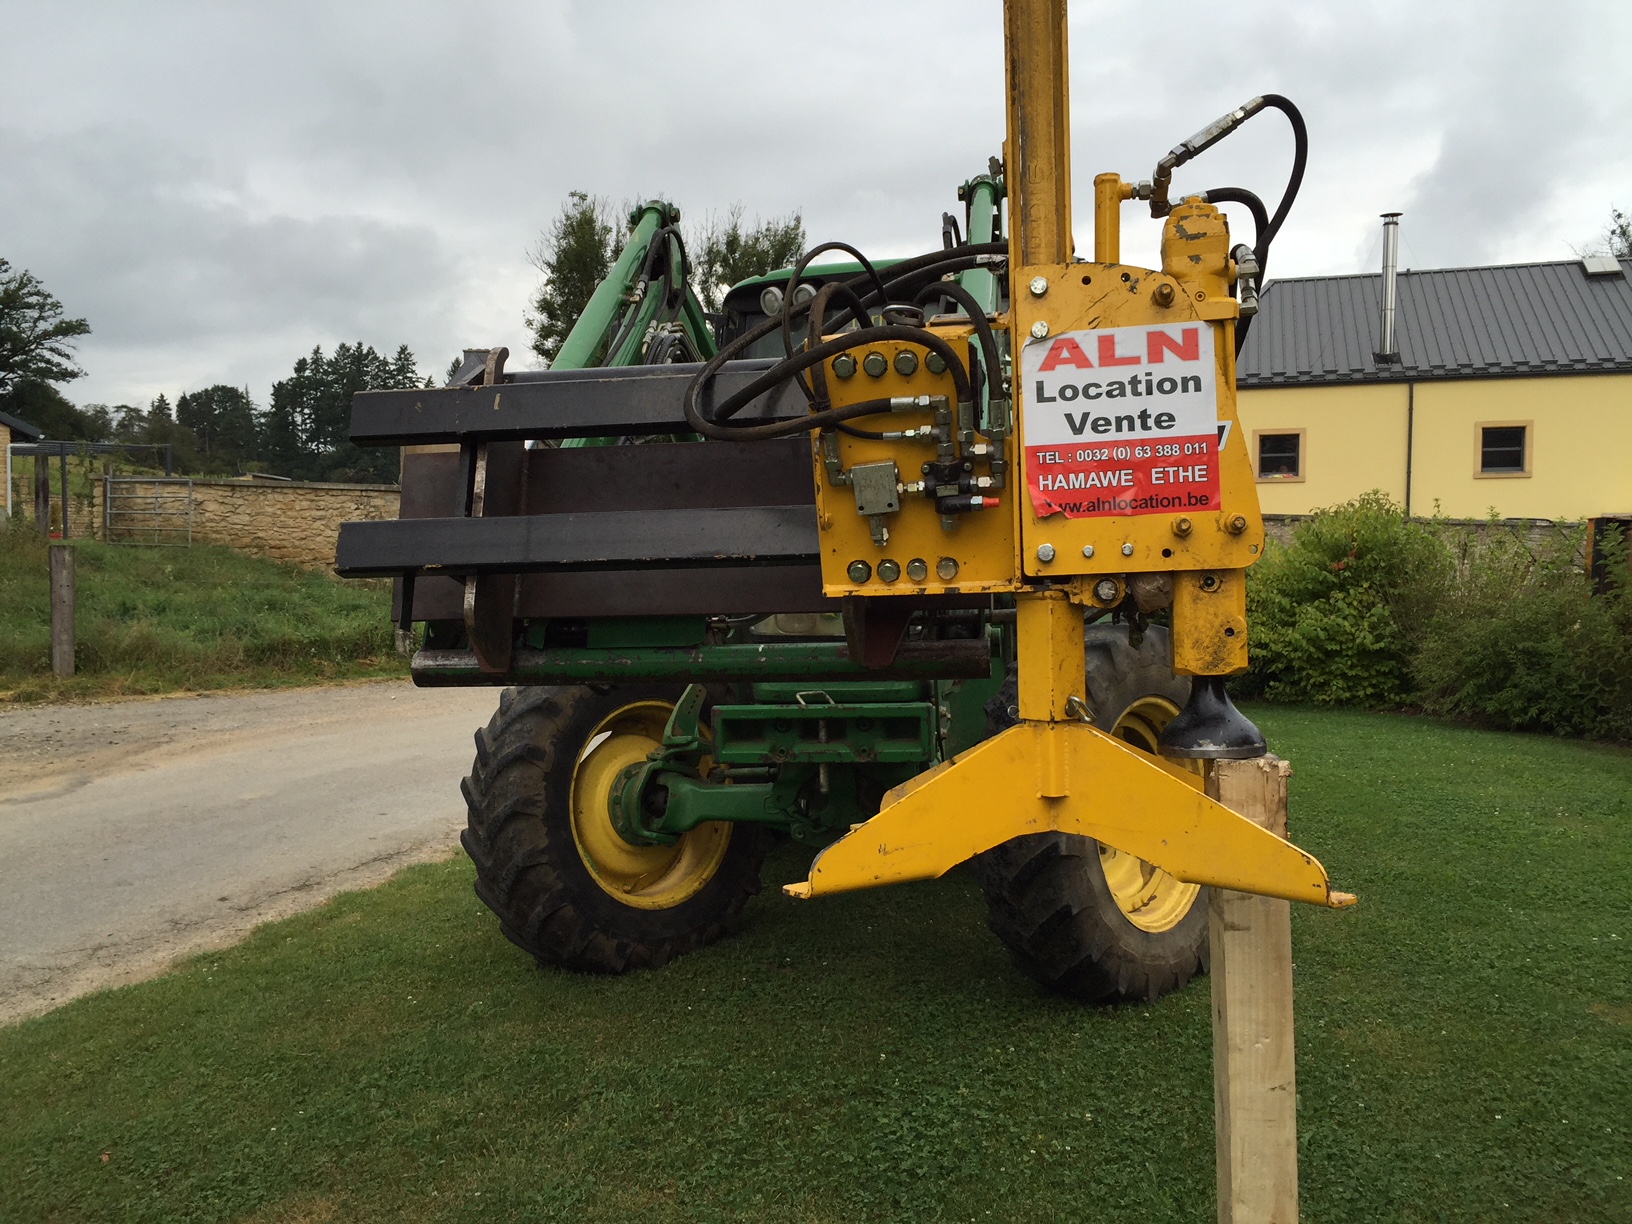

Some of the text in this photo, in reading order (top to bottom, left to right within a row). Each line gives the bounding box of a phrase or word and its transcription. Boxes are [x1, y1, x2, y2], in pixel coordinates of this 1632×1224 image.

[1037, 327, 1200, 373] ALN
[1035, 371, 1202, 404] Location
[1064, 407, 1177, 436] Vente
[1036, 451, 1065, 465] TEL
[1076, 448, 1109, 462] 0032
[1113, 445, 1131, 461] (0)
[1135, 446, 1152, 458] 63
[1155, 444, 1180, 457] 388
[1184, 442, 1208, 455] 011
[1038, 464, 1208, 491] HAMAWE ETHE
